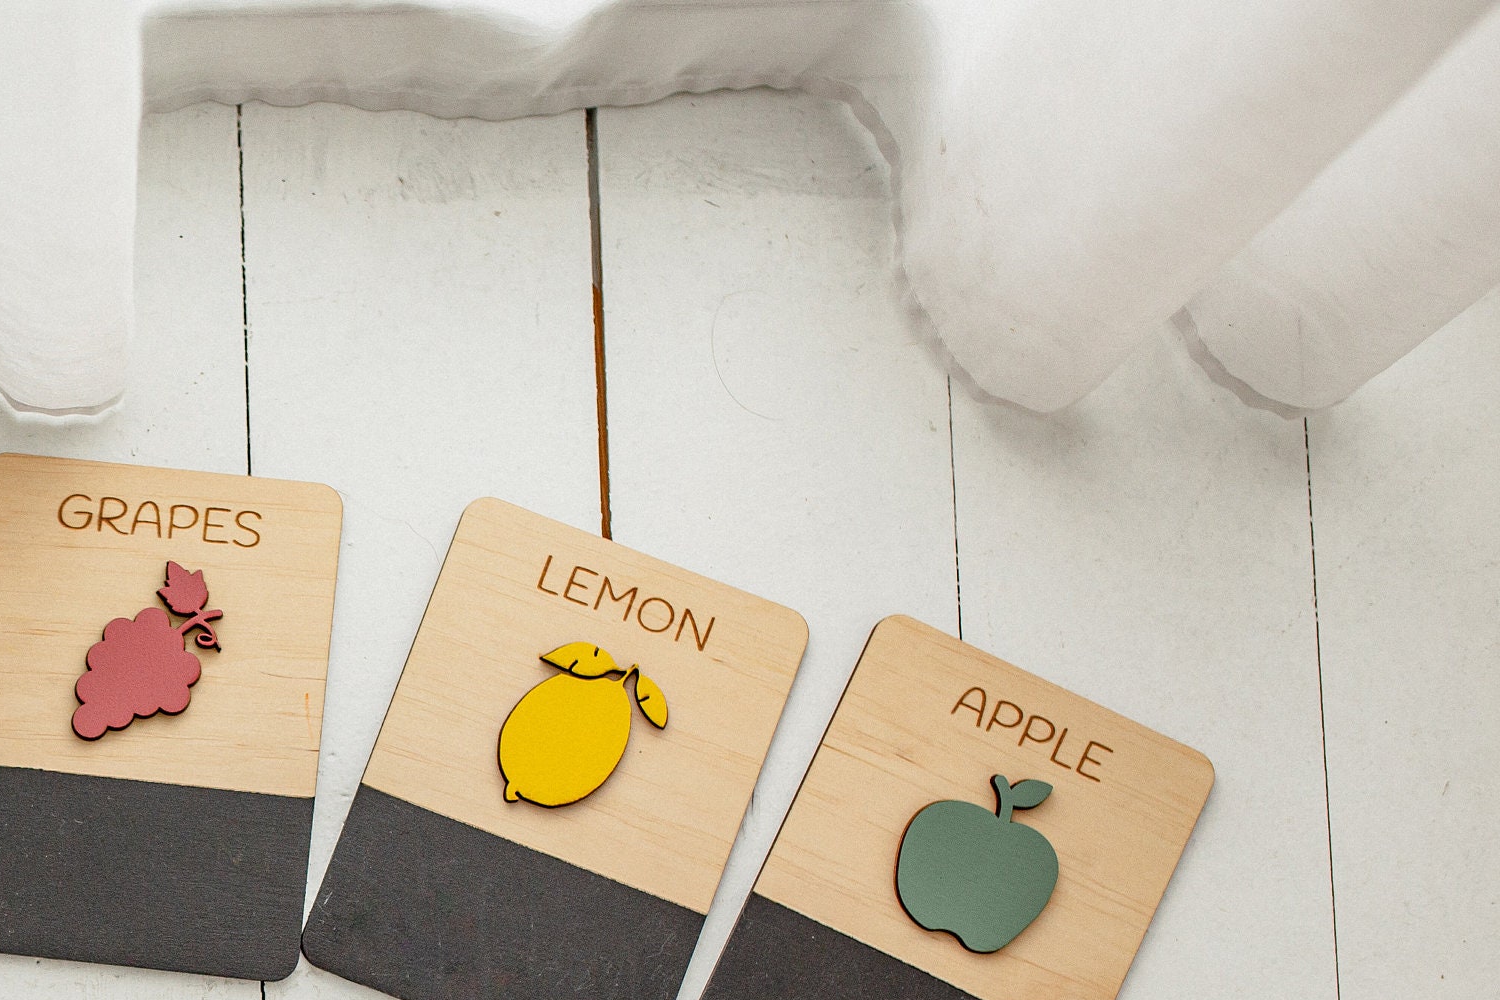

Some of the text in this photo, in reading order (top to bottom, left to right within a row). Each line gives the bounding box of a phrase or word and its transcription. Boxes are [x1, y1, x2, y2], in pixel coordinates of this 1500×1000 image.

[57, 494, 262, 548] GRAPES
[537, 555, 716, 652] LEMON
[951, 687, 1114, 782] APPLE
